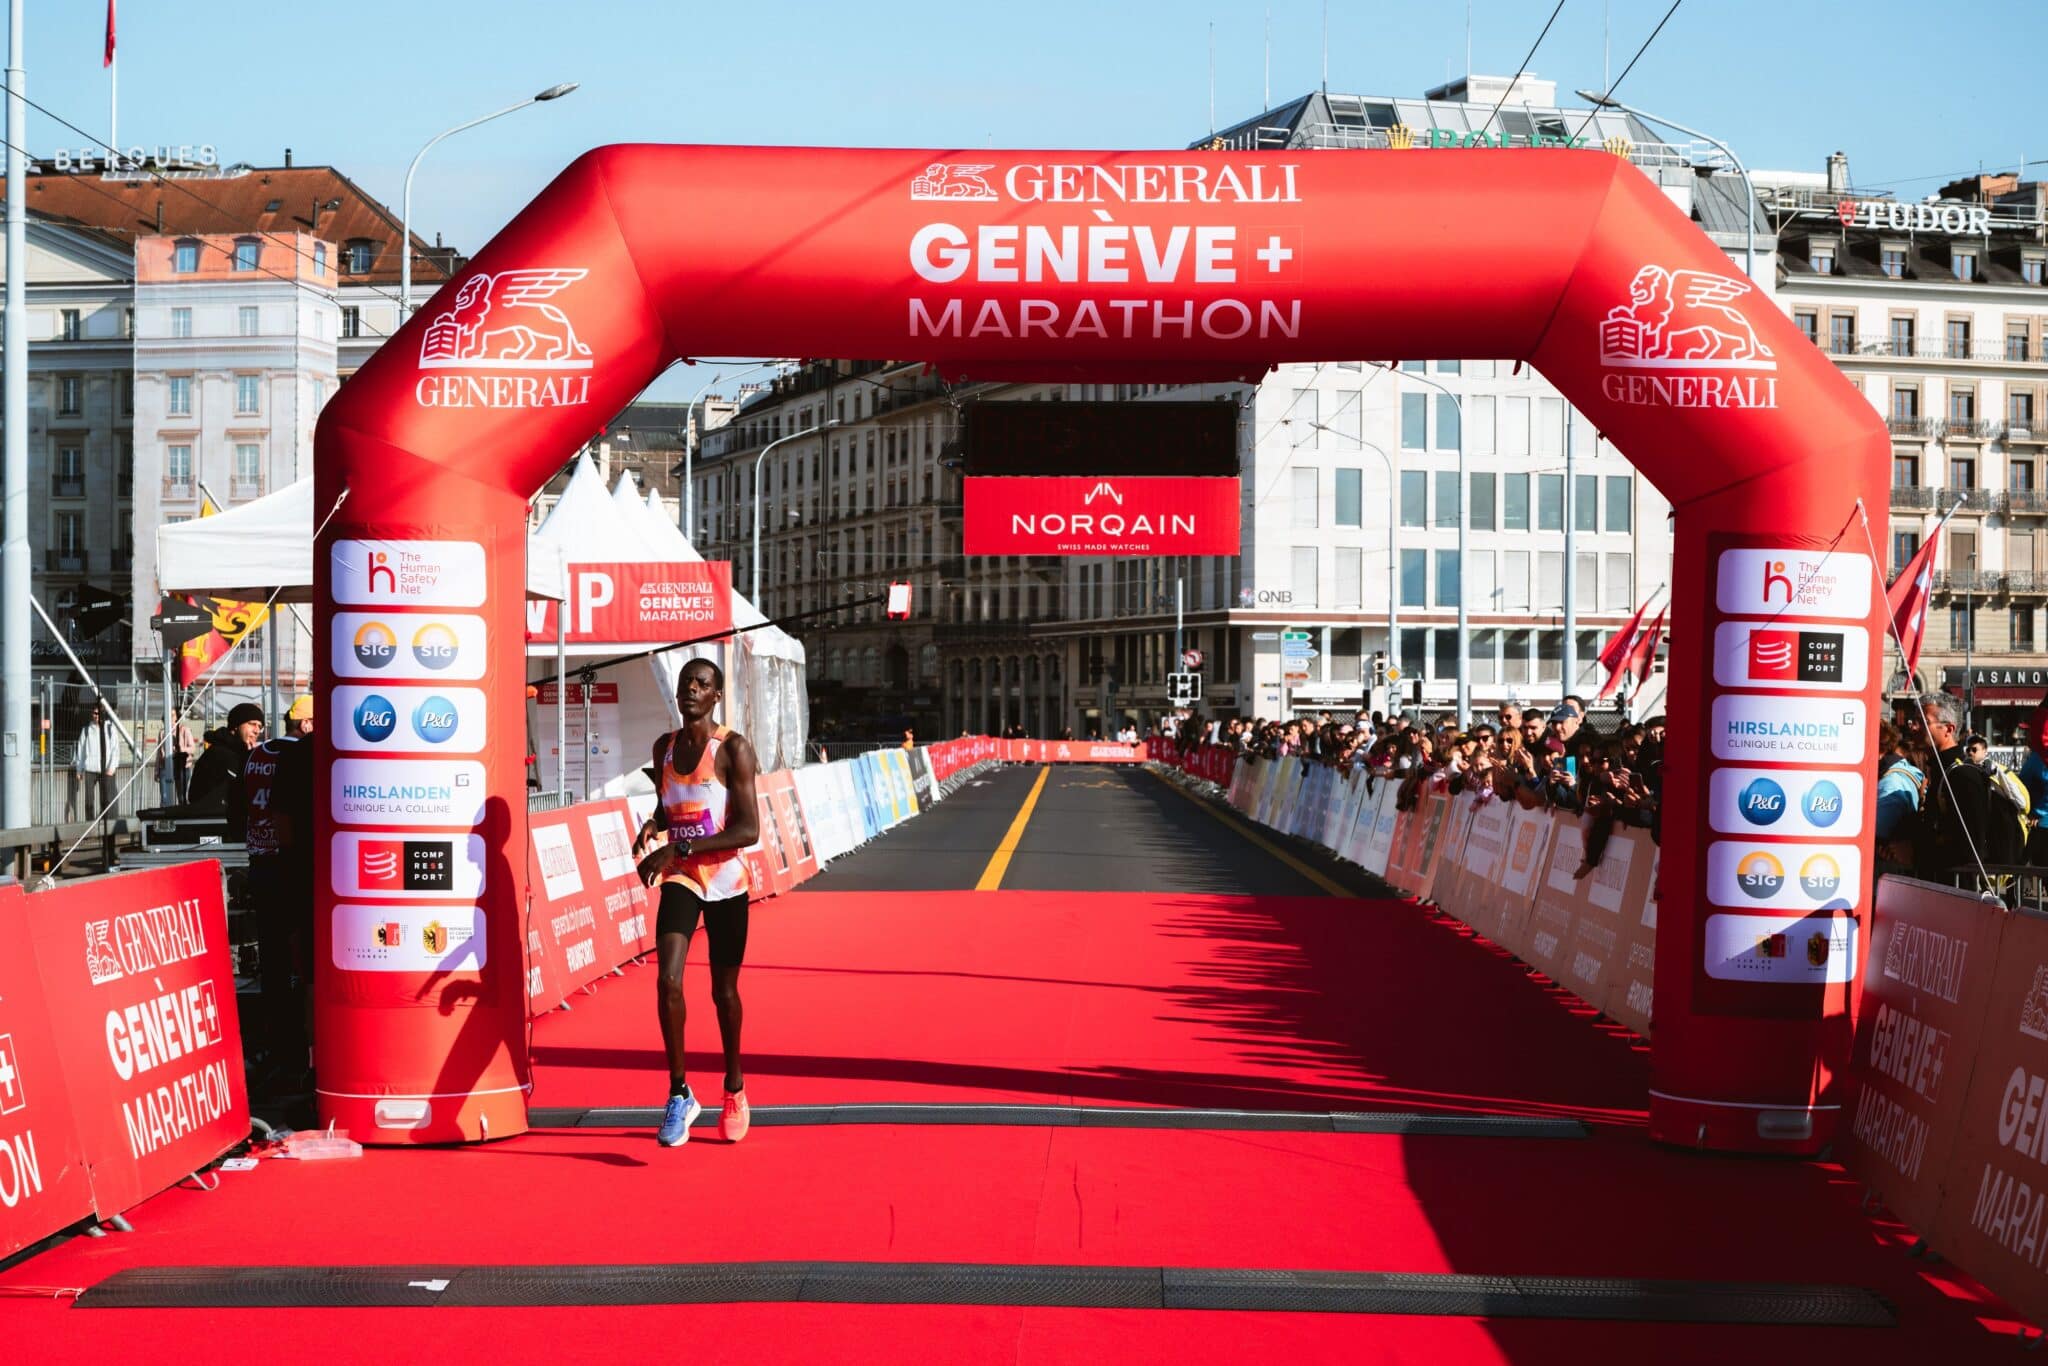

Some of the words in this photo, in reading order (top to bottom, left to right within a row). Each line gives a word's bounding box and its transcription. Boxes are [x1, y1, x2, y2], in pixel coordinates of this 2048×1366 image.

[55, 144, 217, 171] BERGUES
[1005, 164, 1302, 203] GENERALI
[1862, 202, 1992, 235] TUDOR
[909, 210, 1236, 283] GENÈVE
[908, 298, 1301, 339] MARATHON
[416, 375, 590, 409] GENERALI
[1601, 374, 1779, 410] GENERALI
[1012, 515, 1195, 536] NORQAIN
[400, 552, 421, 562] The
[400, 563, 440, 573] Human
[1799, 562, 1819, 572] The
[400, 573, 437, 585] Safety
[1799, 574, 1837, 584] Human
[400, 584, 421, 594] Net
[657, 582, 712, 593] GENERALI
[1799, 584, 1832, 596] Safety
[640, 594, 702, 609] GENÈVE
[1258, 590, 1293, 604] QNB
[1798, 594, 1817, 605] Net
[640, 611, 714, 621] MARATHON
[361, 645, 389, 656] SIG
[421, 646, 452, 657] SIG
[1808, 642, 1836, 650] COMP
[1808, 664, 1836, 672] PORT
[1977, 671, 2048, 684] ASANO
[361, 711, 392, 727] P&G
[422, 711, 455, 728] P&G
[1728, 720, 1839, 737] HIRSLANDEN
[1728, 739, 1777, 750] CLINIQUE
[1780, 741, 1793, 750] LA
[1798, 742, 1838, 751] COLLINE
[247, 762, 279, 775] PHOT
[343, 785, 451, 800] HIRSLANDEN
[343, 803, 385, 813] CLINIQUE
[389, 804, 402, 813] LA
[405, 804, 450, 814] COLLINE
[1747, 794, 1781, 811] P&G
[1810, 795, 1839, 813] P&G
[671, 825, 705, 839] 7035
[414, 862, 444, 870] RESS
[414, 873, 444, 881] PORT
[1745, 875, 1777, 887] SIG
[1807, 876, 1835, 888] SIG
[113, 898, 208, 976] GENERALI
[1901, 926, 1968, 1004] GENERALI
[105, 977, 208, 1081] GENÈVE
[1870, 997, 1937, 1096] GENÈVE
[122, 1059, 232, 1160] MARATHON
[1853, 1083, 1929, 1182] MARATHON
